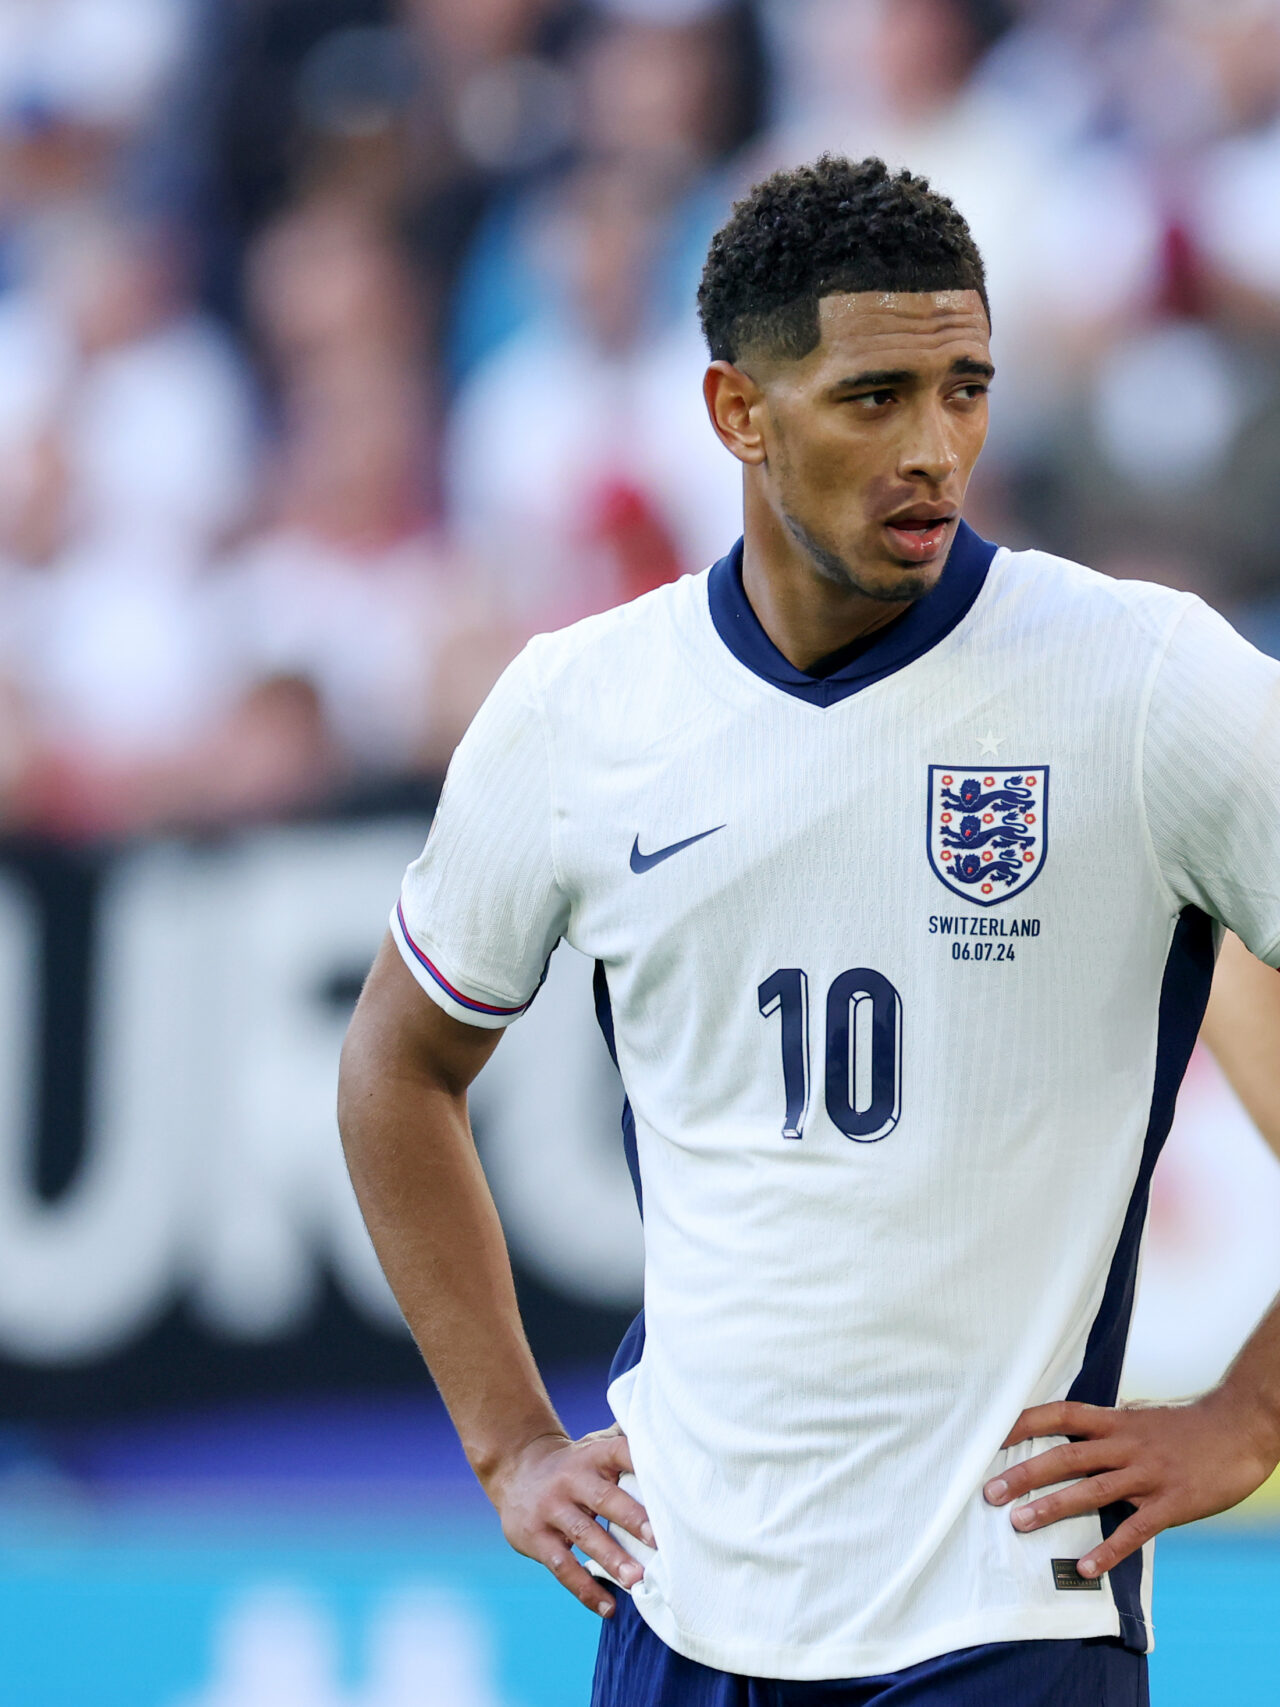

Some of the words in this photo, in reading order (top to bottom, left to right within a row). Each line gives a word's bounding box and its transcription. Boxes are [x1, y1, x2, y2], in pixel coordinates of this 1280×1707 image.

[929, 915, 1040, 937] SWITZERLAND
[952, 942, 1015, 961] 06.07.24
[758, 967, 903, 1143] 10
